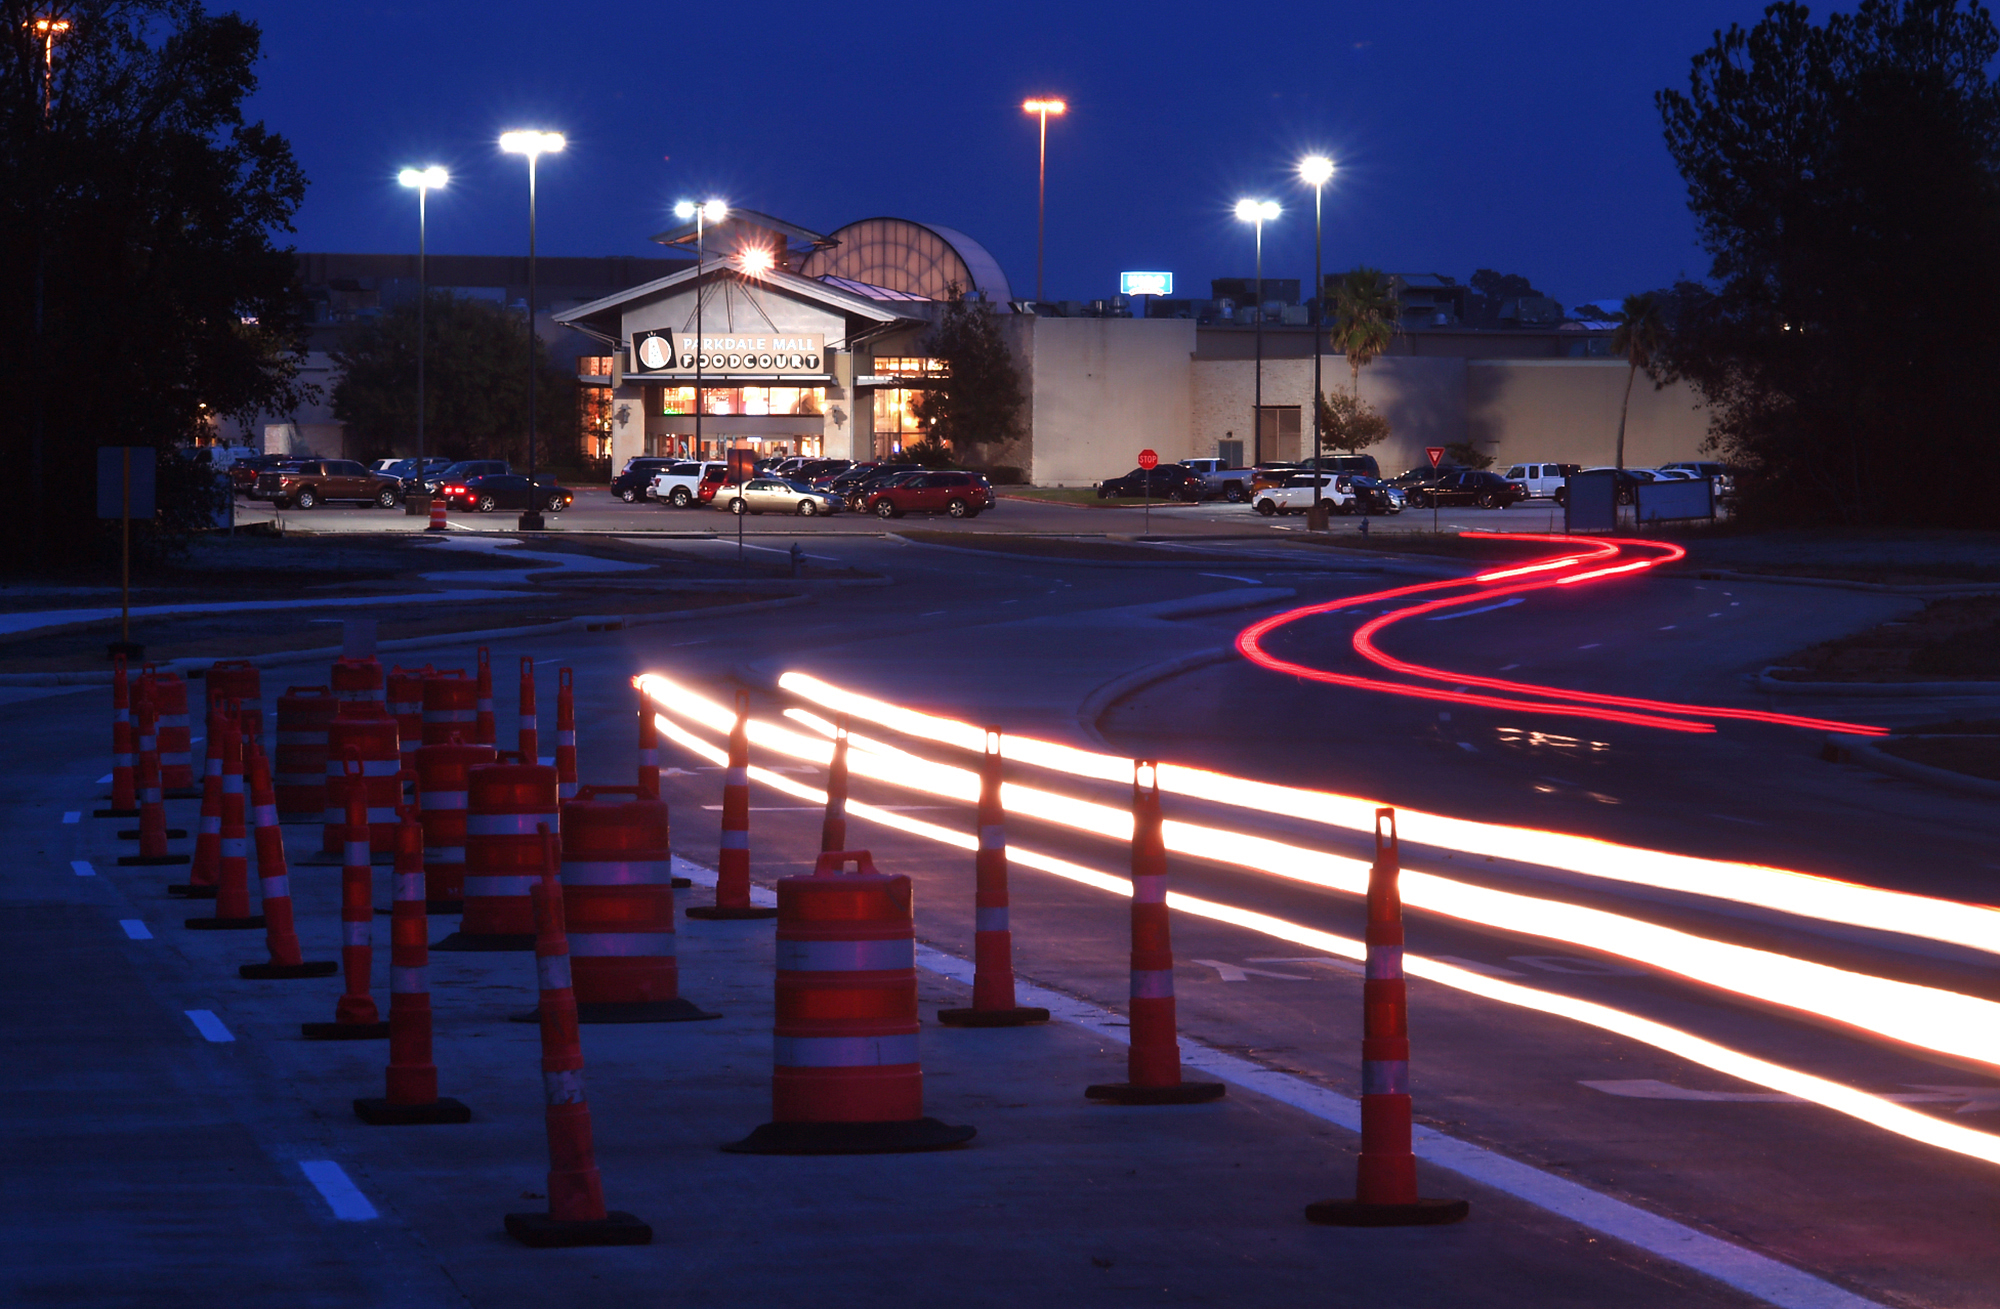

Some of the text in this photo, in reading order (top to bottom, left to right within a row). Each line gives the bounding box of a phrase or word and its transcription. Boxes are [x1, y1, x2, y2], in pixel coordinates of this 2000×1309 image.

[682, 338, 816, 351] PARKDALE MALL
[1139, 455, 1157, 464] STOP
